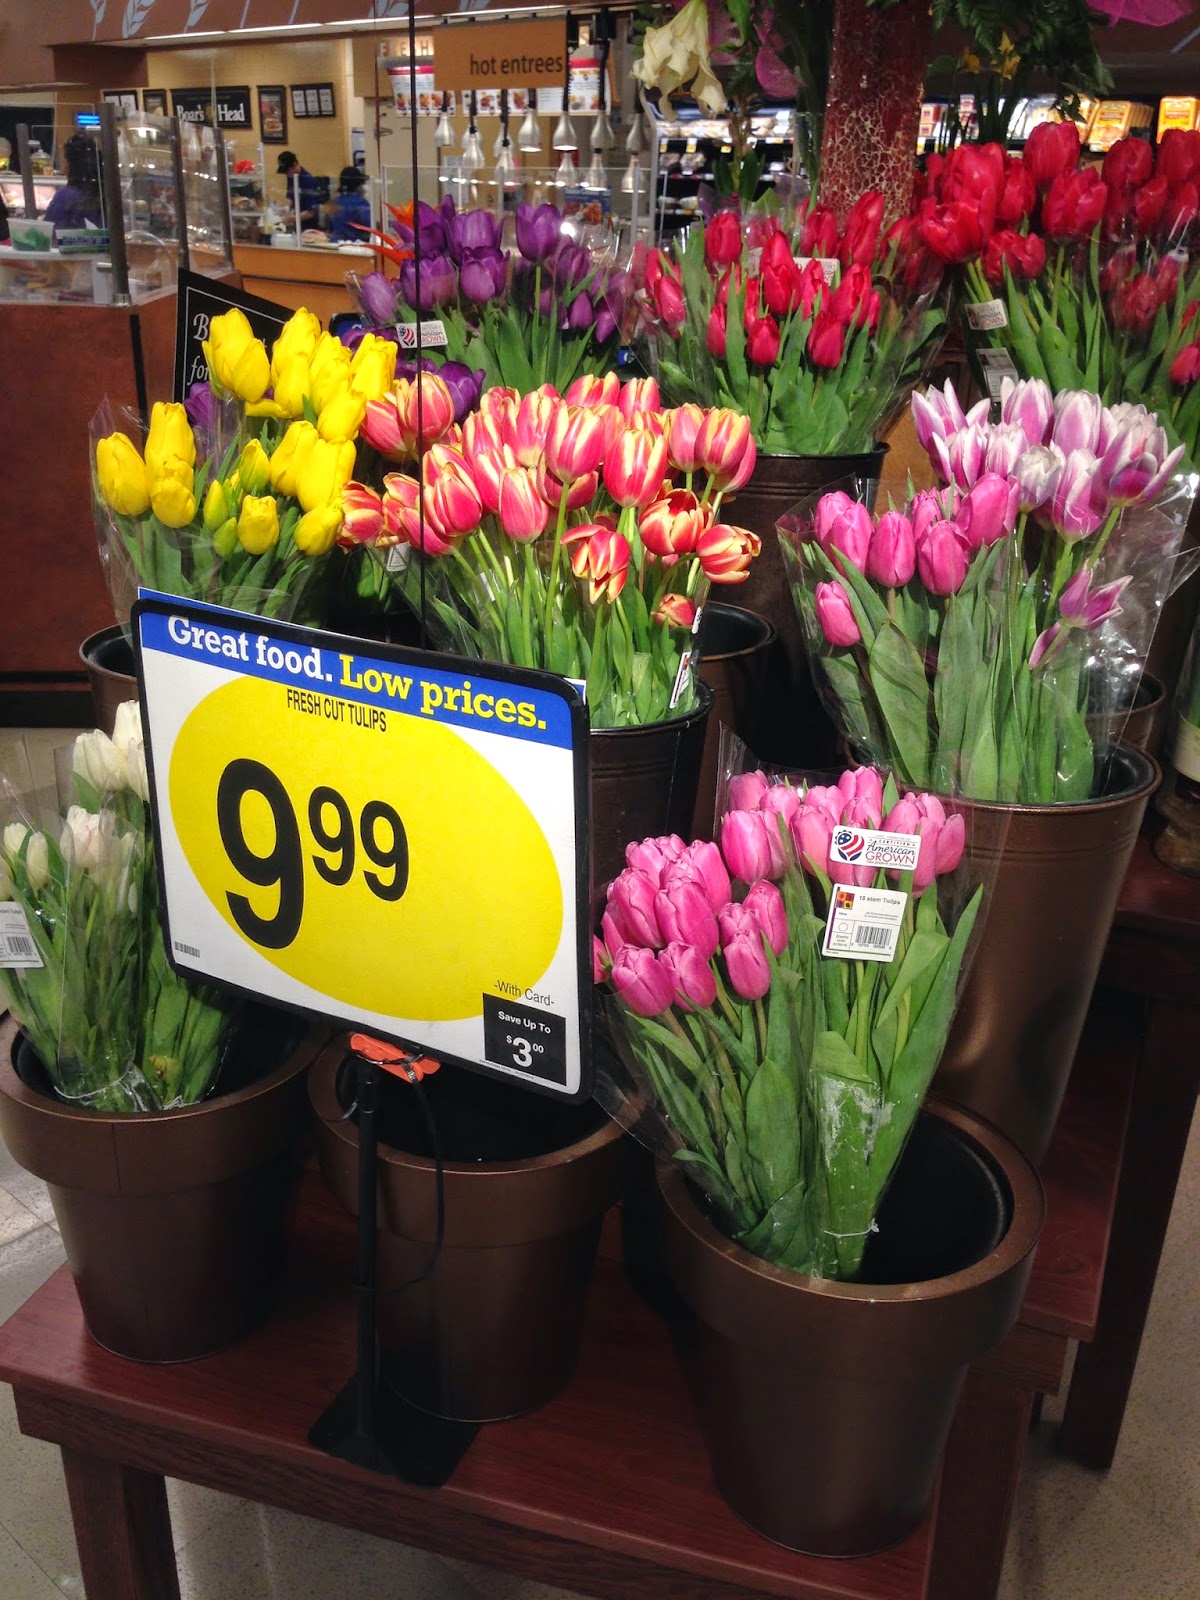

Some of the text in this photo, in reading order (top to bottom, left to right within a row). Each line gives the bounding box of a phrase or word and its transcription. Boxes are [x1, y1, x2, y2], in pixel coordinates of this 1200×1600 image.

[470, 54, 563, 76] hot entrees
[176, 103, 245, 122] Boar's Head
[167, 615, 548, 731] Great food. Low prices.
[286, 688, 388, 733] FRESH CUT TULIPS
[865, 850, 915, 865] GROWN
[866, 840, 916, 856] American
[498, 1010, 552, 1034] Save Up To
